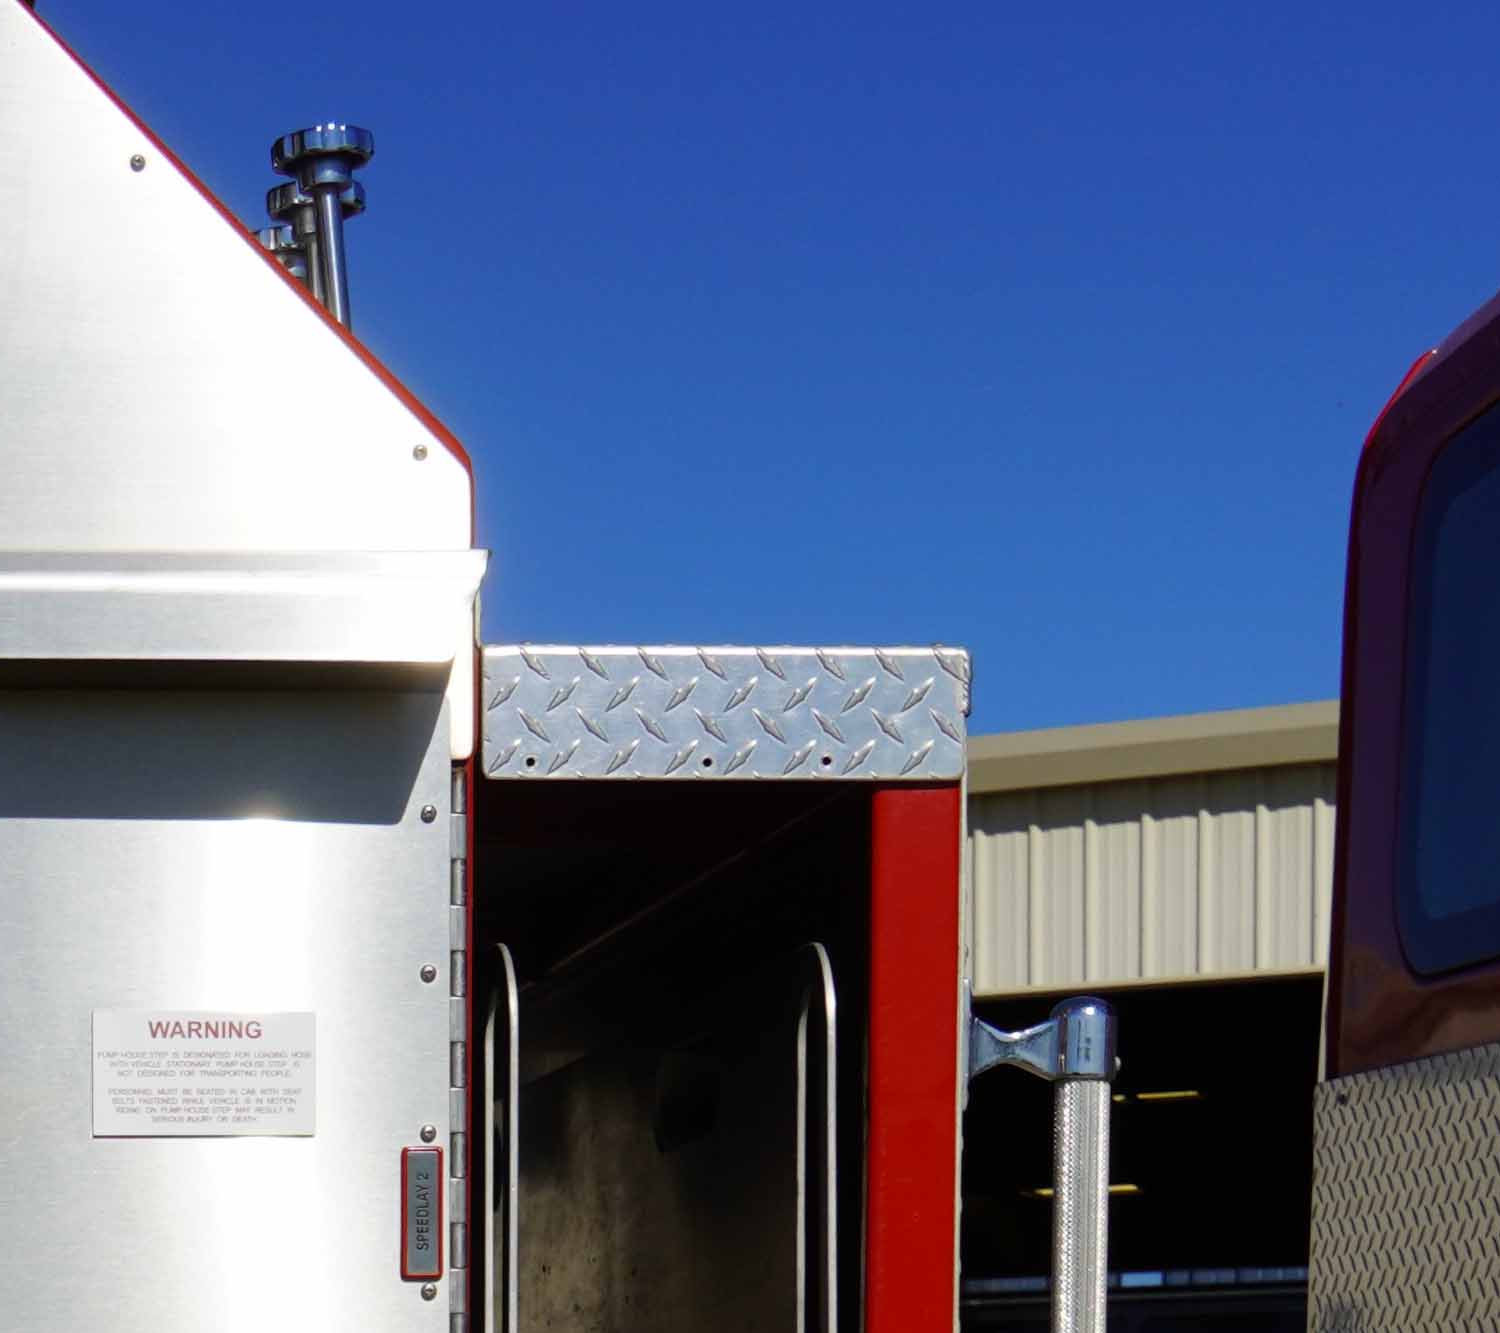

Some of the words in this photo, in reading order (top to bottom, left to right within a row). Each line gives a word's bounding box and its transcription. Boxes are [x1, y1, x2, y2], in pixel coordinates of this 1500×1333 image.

[148, 1020, 263, 1039] WARNING
[416, 1173, 430, 1181] 2
[416, 1187, 430, 1251] SPEEDLAY
